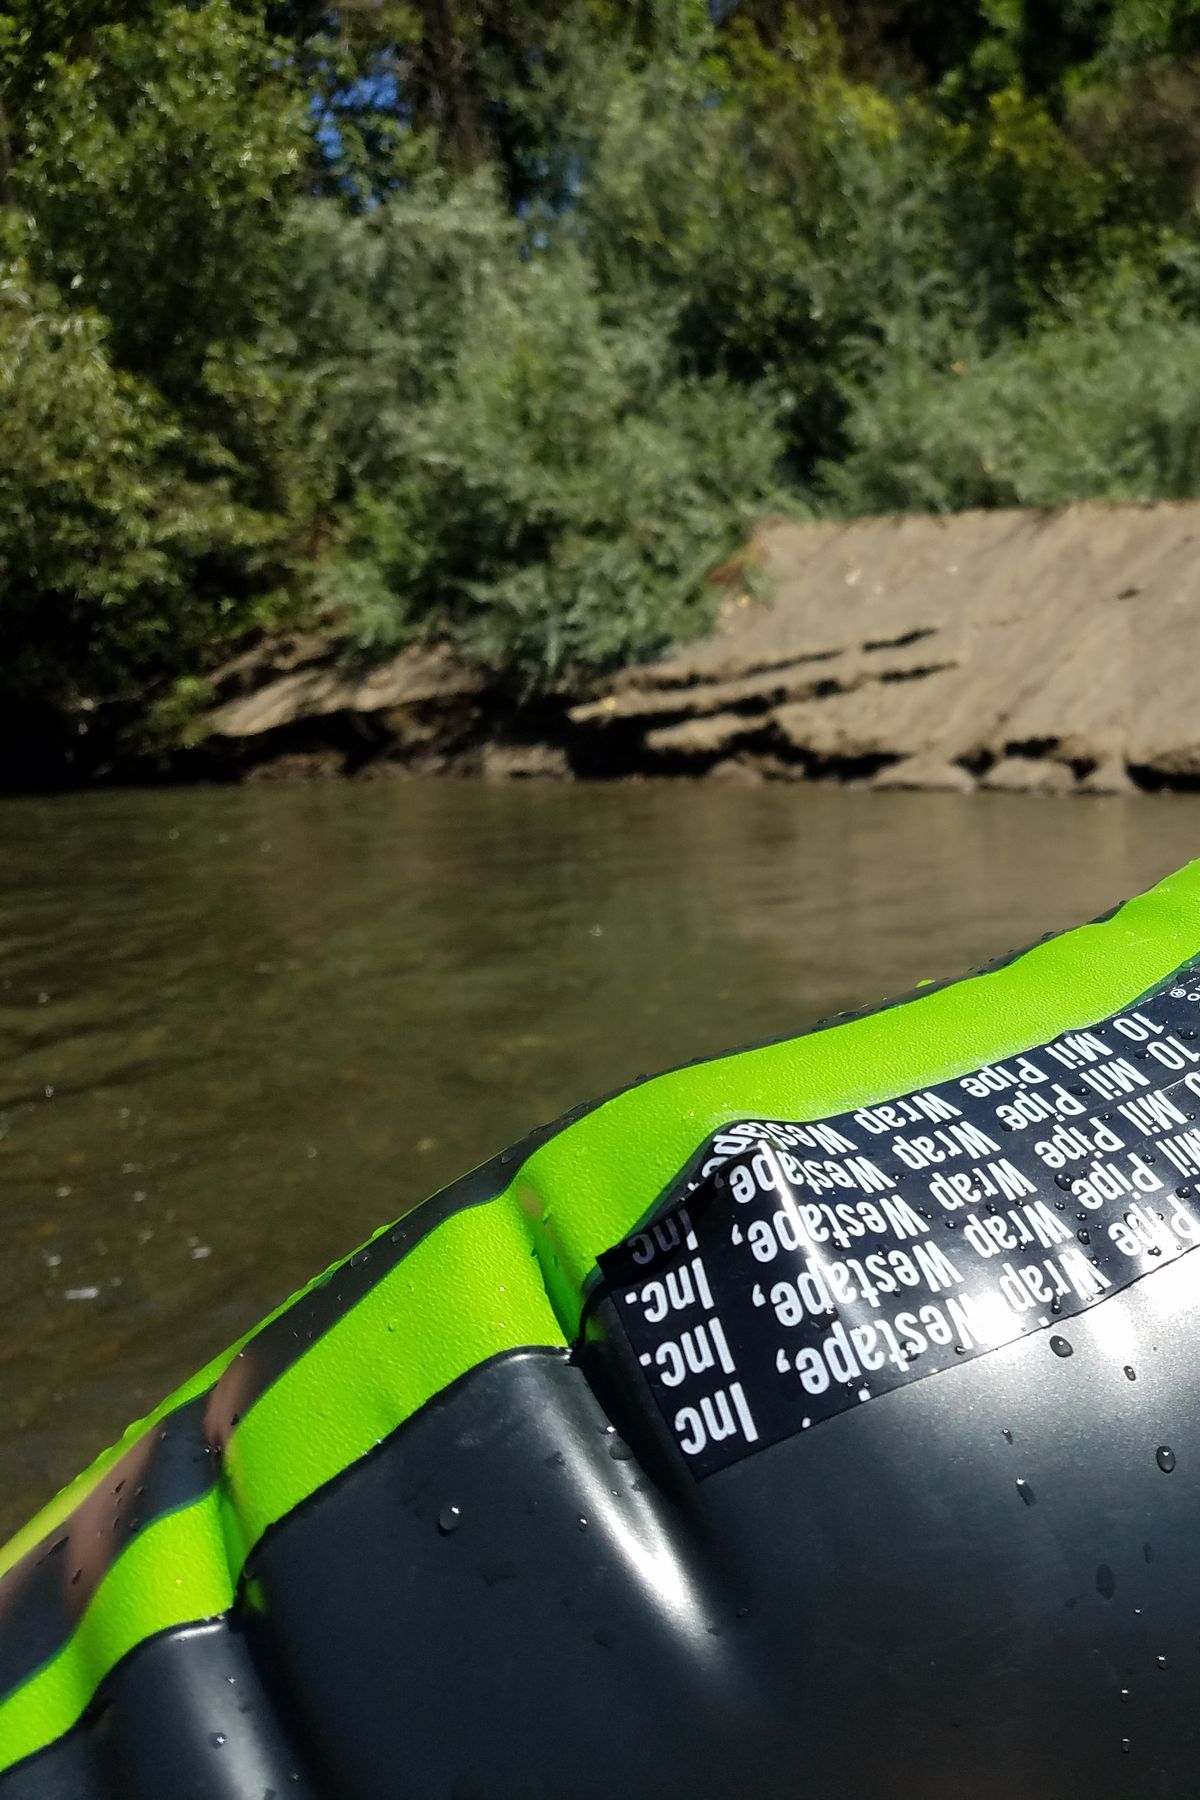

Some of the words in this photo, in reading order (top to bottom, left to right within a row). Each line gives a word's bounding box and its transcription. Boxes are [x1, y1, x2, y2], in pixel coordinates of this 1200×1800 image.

[1045, 1032, 1114, 1070] Mil
[1113, 1012, 1165, 1041] 10
[959, 1057, 1049, 1097] Pipe
[1147, 1036, 1200, 1070] 10
[1079, 1058, 1150, 1100] Mil
[853, 1092, 963, 1135] Wrap
[995, 1083, 1088, 1130] Pipe
[1117, 1089, 1189, 1136] Mil
[892, 1121, 1002, 1170] Wrap
[1034, 1117, 1126, 1168] Pipe
[929, 1158, 1038, 1210] Wrap
[1071, 1152, 1165, 1210] Pipe
[731, 1194, 930, 1263] Westape,
[963, 1200, 1074, 1258] Wrap
[625, 1256, 715, 1322] Inc.
[752, 1241, 965, 1327] Westape,
[999, 1248, 1113, 1312] Wrap
[639, 1316, 736, 1387] Inc.
[674, 1381, 759, 1455] Inc
